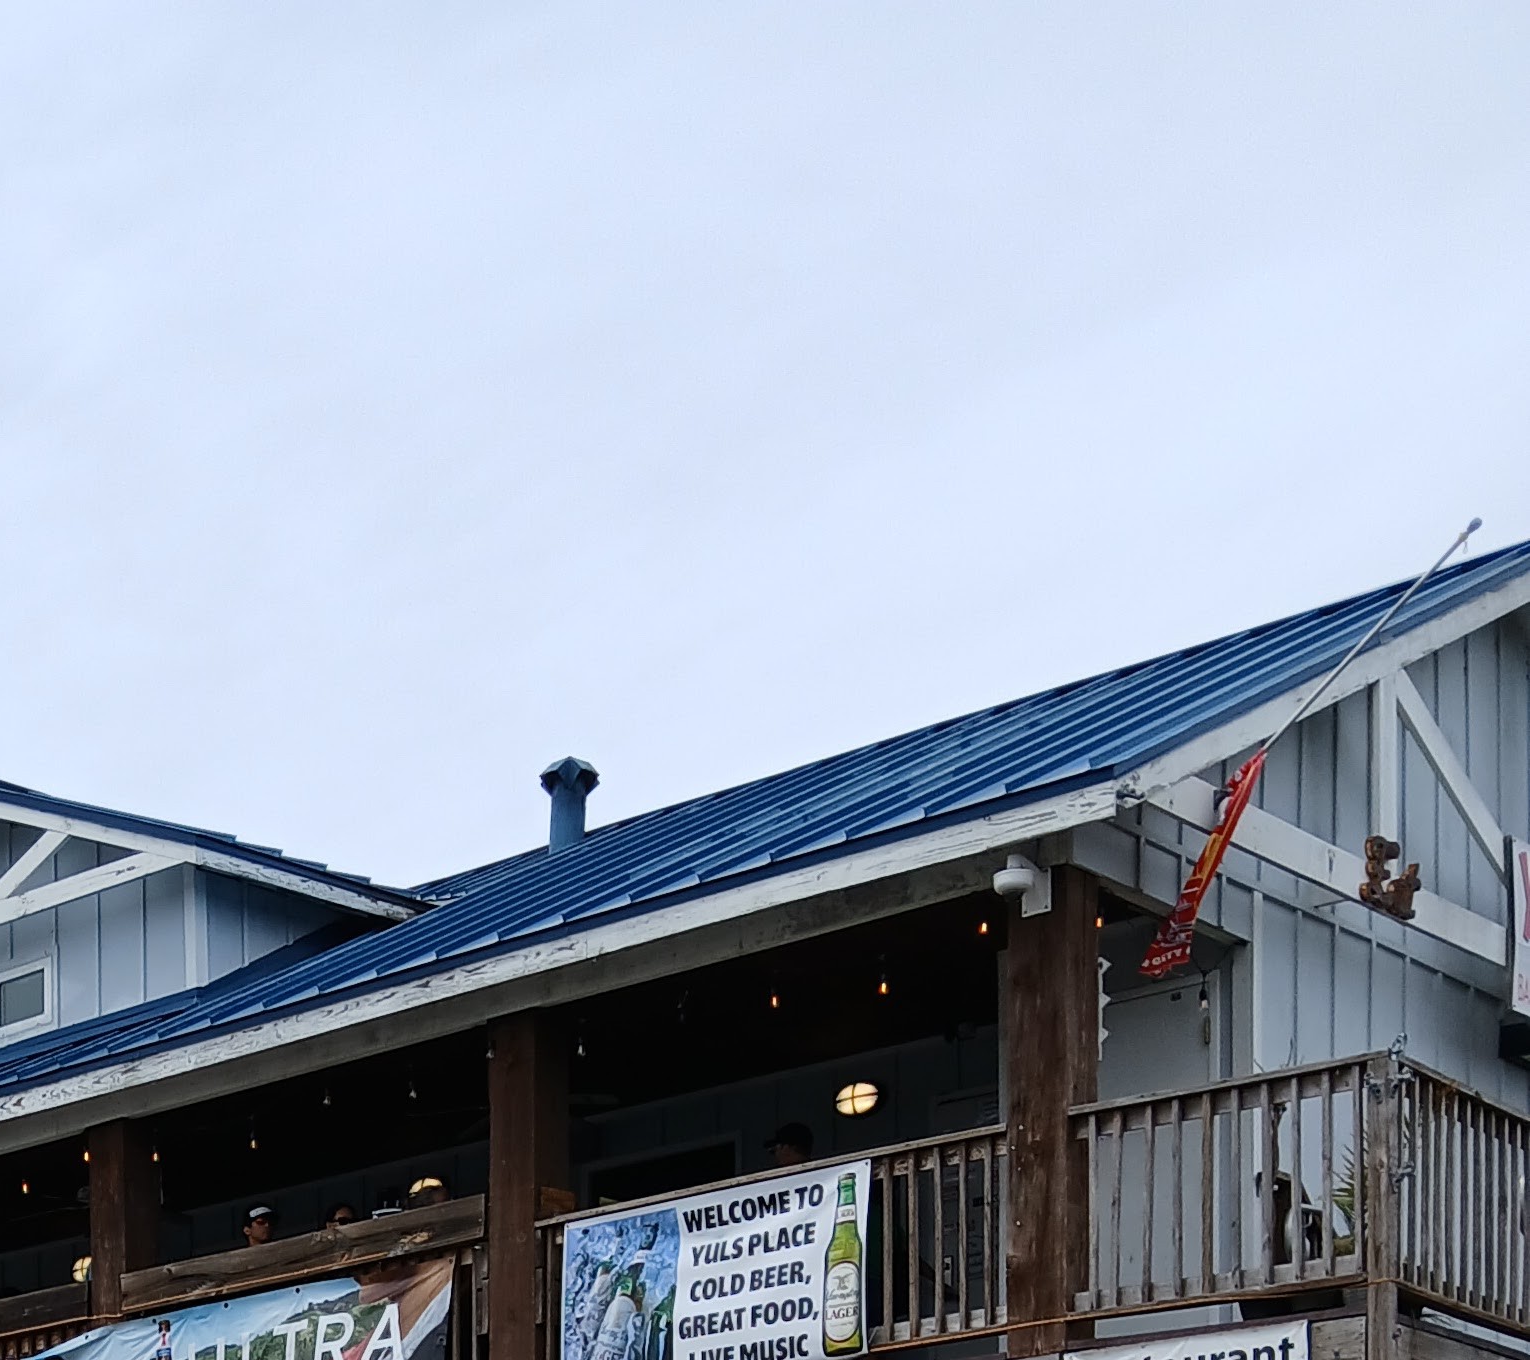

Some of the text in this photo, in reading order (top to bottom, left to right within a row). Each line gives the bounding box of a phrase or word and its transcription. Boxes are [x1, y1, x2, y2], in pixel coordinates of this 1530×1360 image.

[682, 1183, 824, 1234] WELCOME TO
[692, 1221, 817, 1267] YULS PLACE
[689, 1260, 812, 1303] COLD BEER,
[678, 1296, 820, 1341] GREAT FOOD,
[826, 1305, 859, 1321] LAGER
